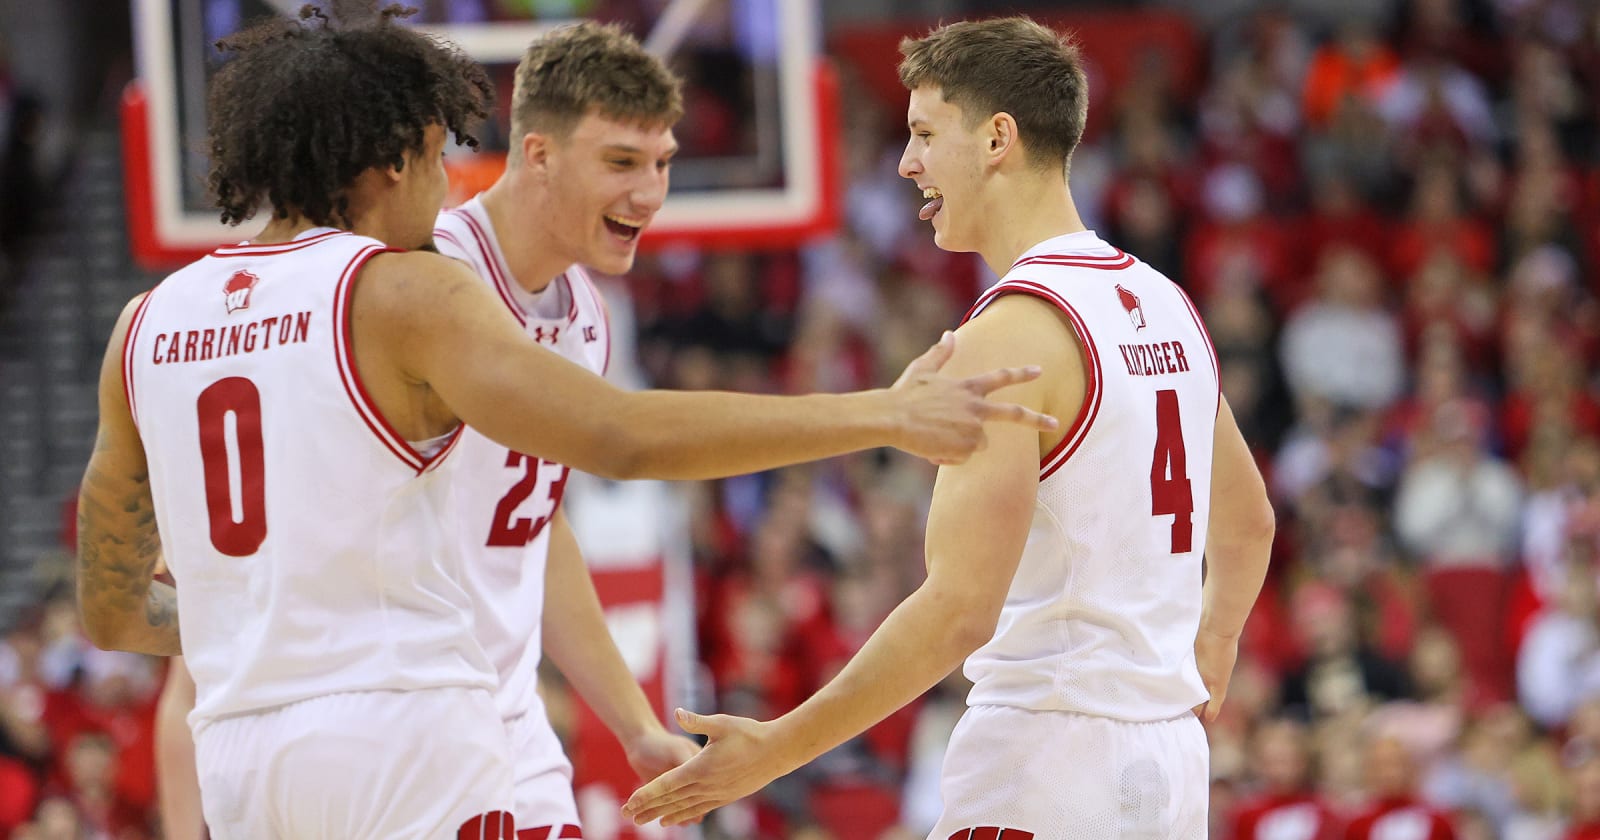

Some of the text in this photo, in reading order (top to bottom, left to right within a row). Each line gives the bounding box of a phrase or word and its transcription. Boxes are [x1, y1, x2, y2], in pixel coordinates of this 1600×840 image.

[153, 310, 311, 364] CARRINGTON
[1118, 341, 1190, 376] KINZIGER
[197, 376, 268, 557] 0
[486, 450, 570, 548] 23
[1150, 389, 1194, 554] 4
